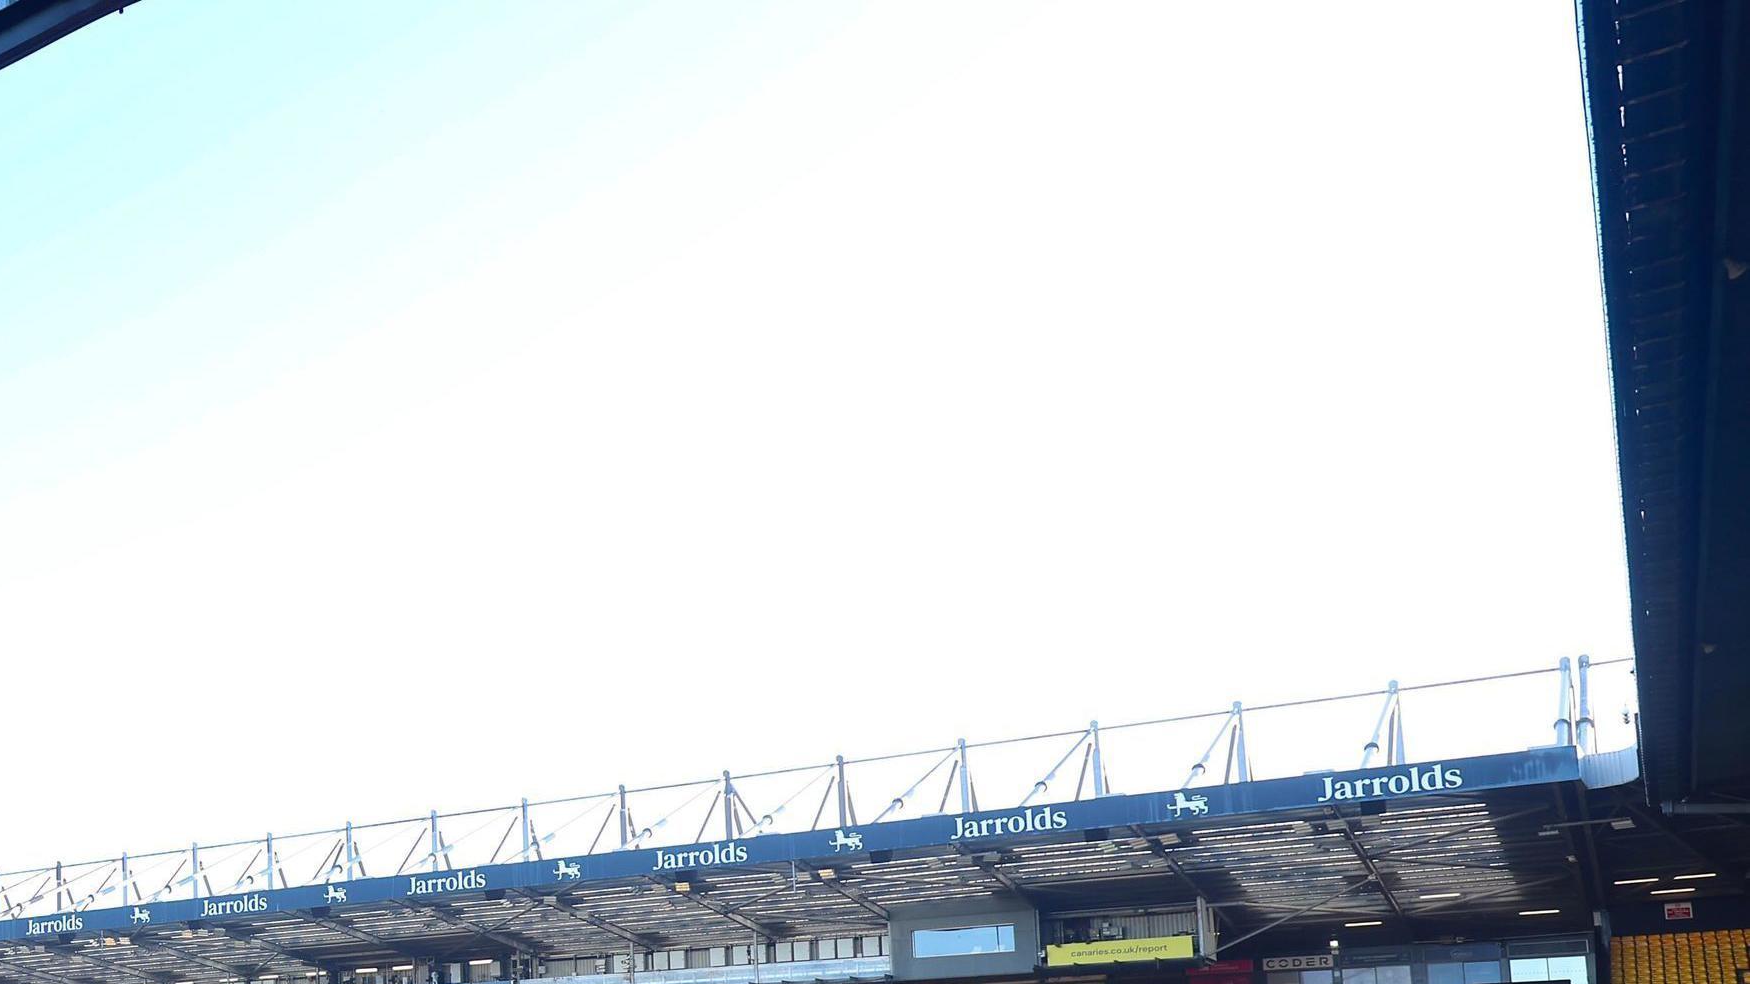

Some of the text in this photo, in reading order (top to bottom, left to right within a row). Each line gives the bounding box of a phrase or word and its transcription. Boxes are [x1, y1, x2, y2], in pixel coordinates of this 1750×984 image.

[1318, 763, 1463, 803] Jarrolds
[951, 807, 1068, 840] Jarrolds
[653, 841, 748, 870] Jarrolds
[407, 871, 486, 896] Jarrolds
[200, 894, 268, 917] Jarrolds
[26, 914, 83, 935] Jarrolds
[1070, 943, 1168, 958] canaries.co.uk/report
[1265, 956, 1331, 969] CODER
